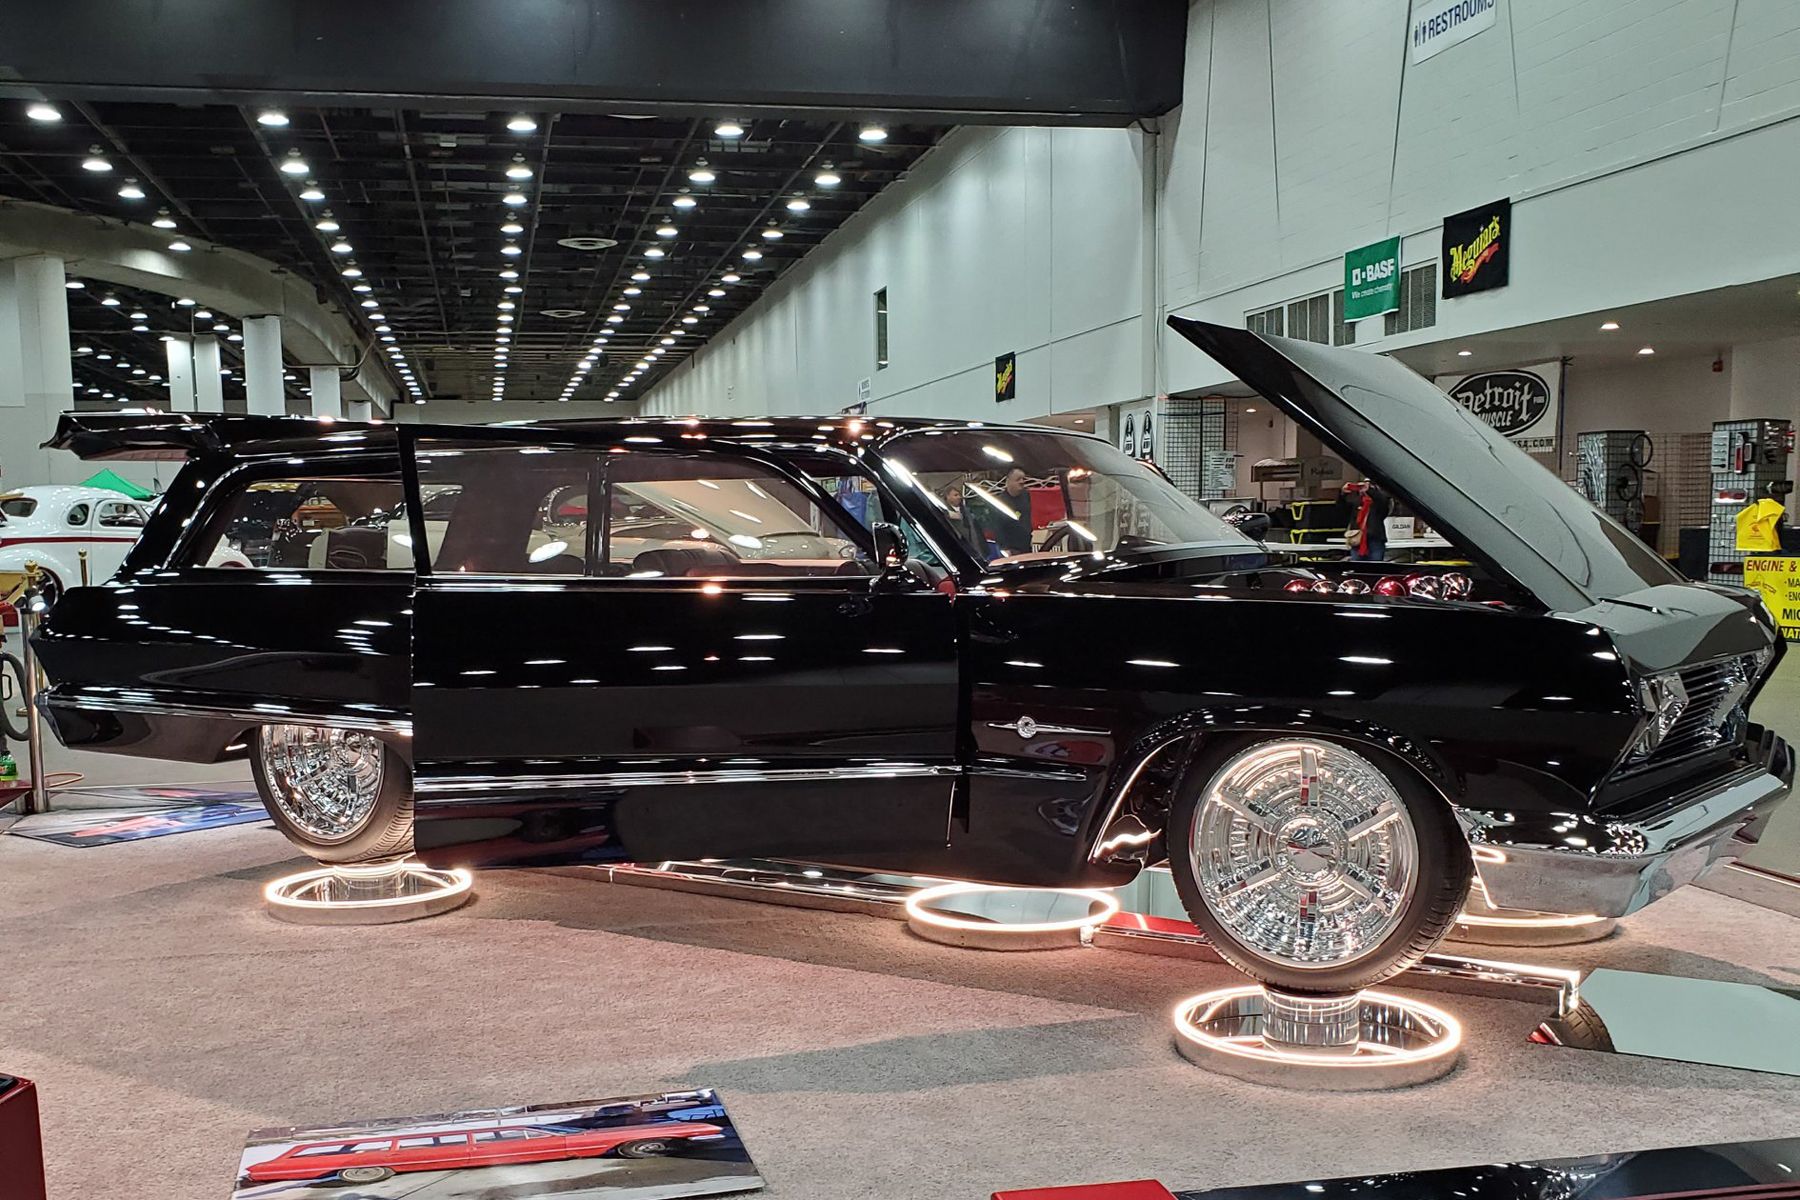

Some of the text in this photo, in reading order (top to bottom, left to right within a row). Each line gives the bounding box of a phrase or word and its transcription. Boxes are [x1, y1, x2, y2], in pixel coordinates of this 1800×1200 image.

[1366, 258, 1395, 282] BASF
[1457, 379, 1533, 422] Detroit
[1746, 559, 1798, 572] ENGINE &
